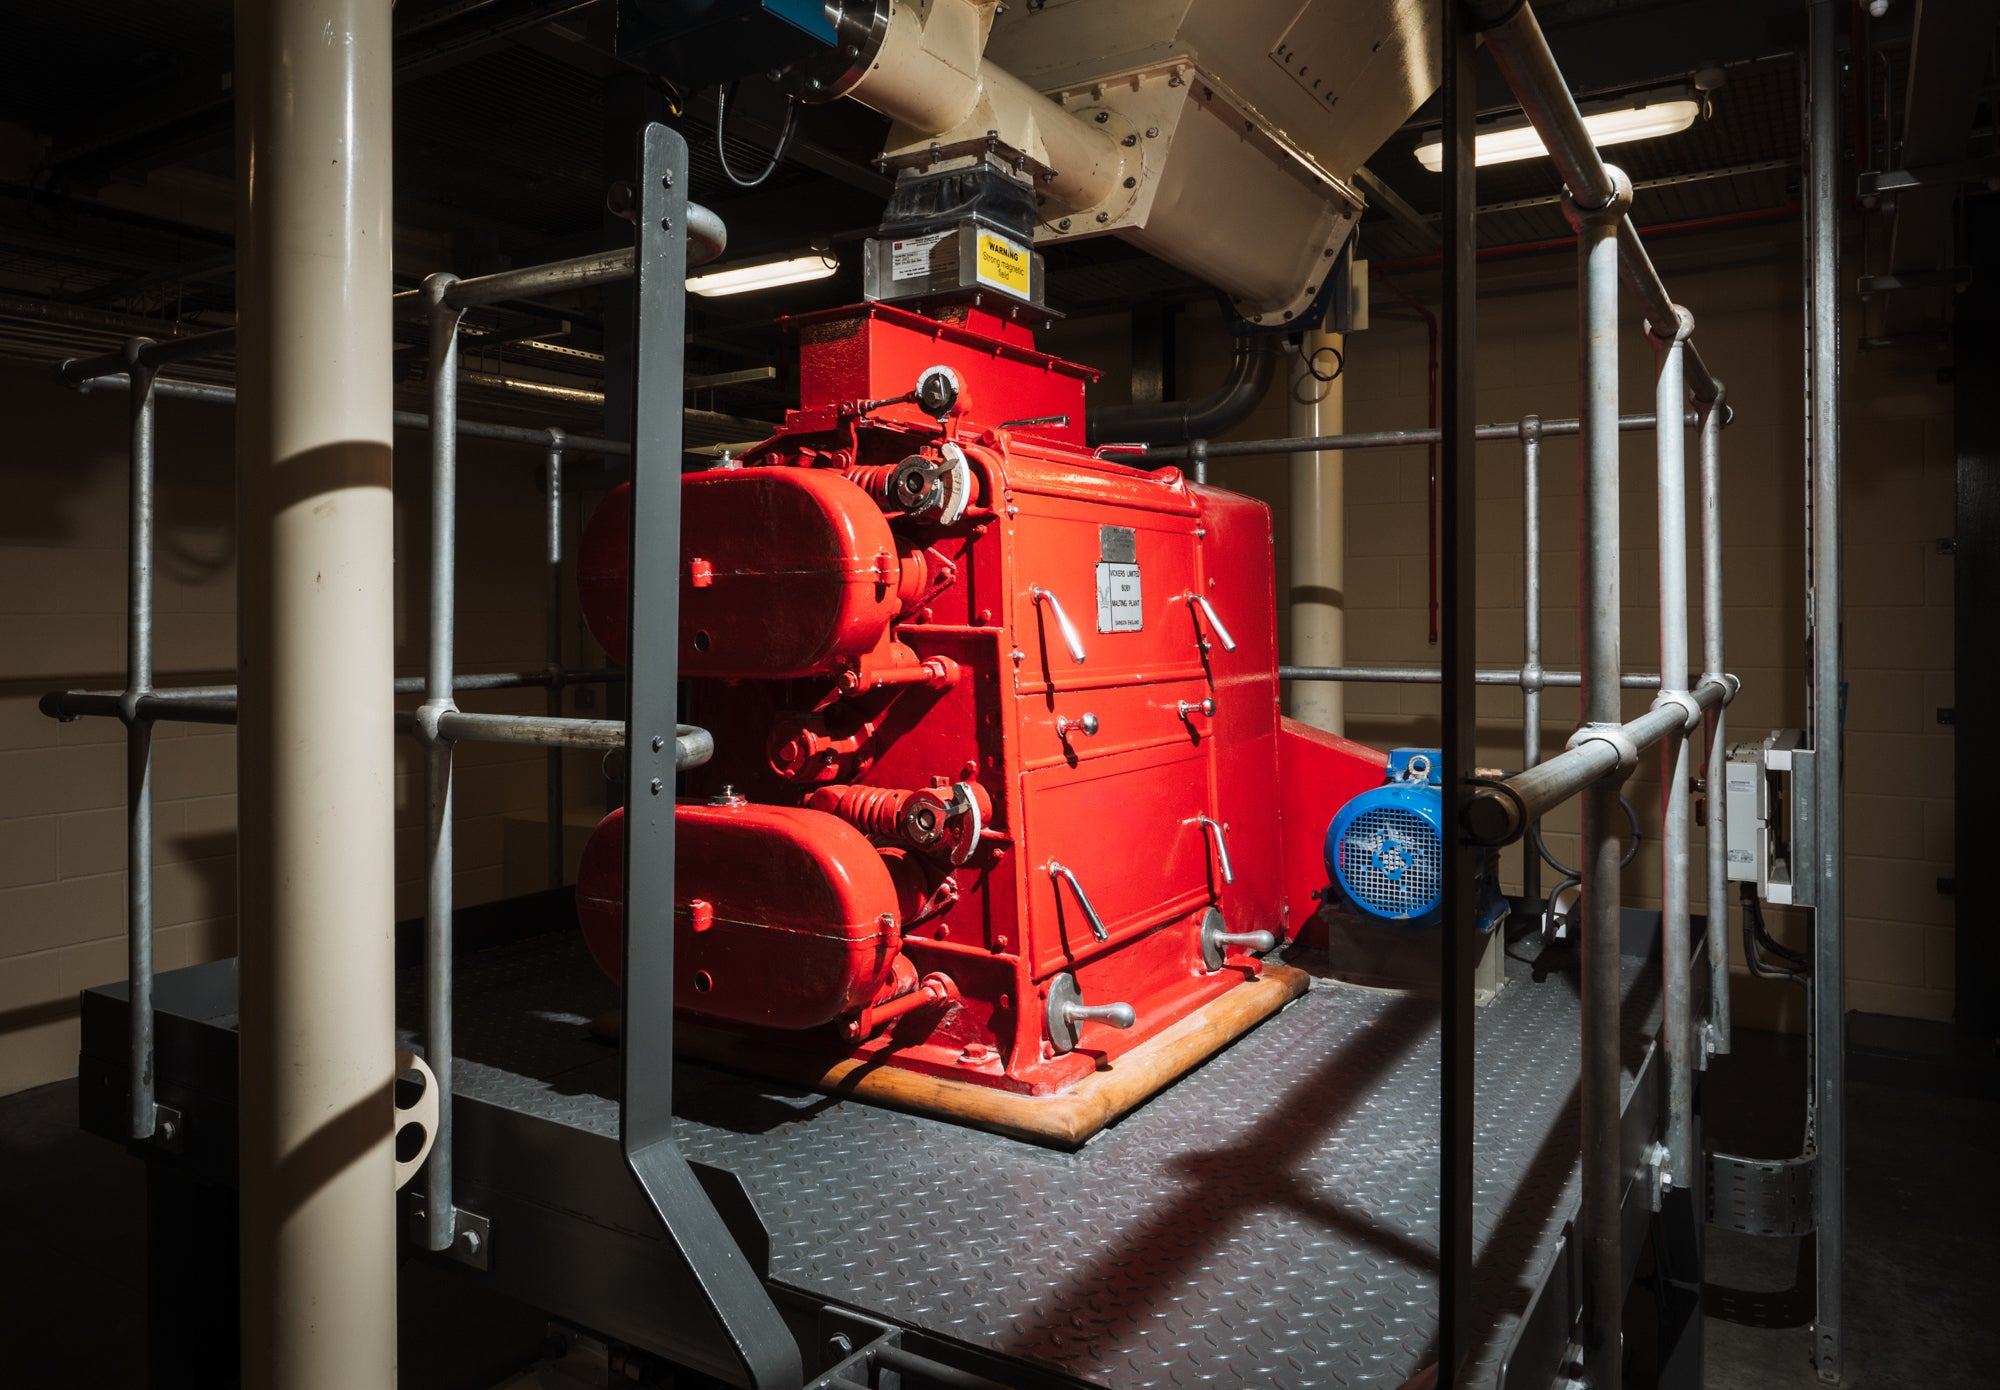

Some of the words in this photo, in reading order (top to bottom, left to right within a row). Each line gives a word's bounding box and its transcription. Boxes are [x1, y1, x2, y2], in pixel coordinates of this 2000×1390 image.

[989, 242, 1018, 261] WARNING
[983, 251, 1000, 268] Strong
[1001, 261, 1024, 276] magnetic
[999, 269, 1009, 280] field
